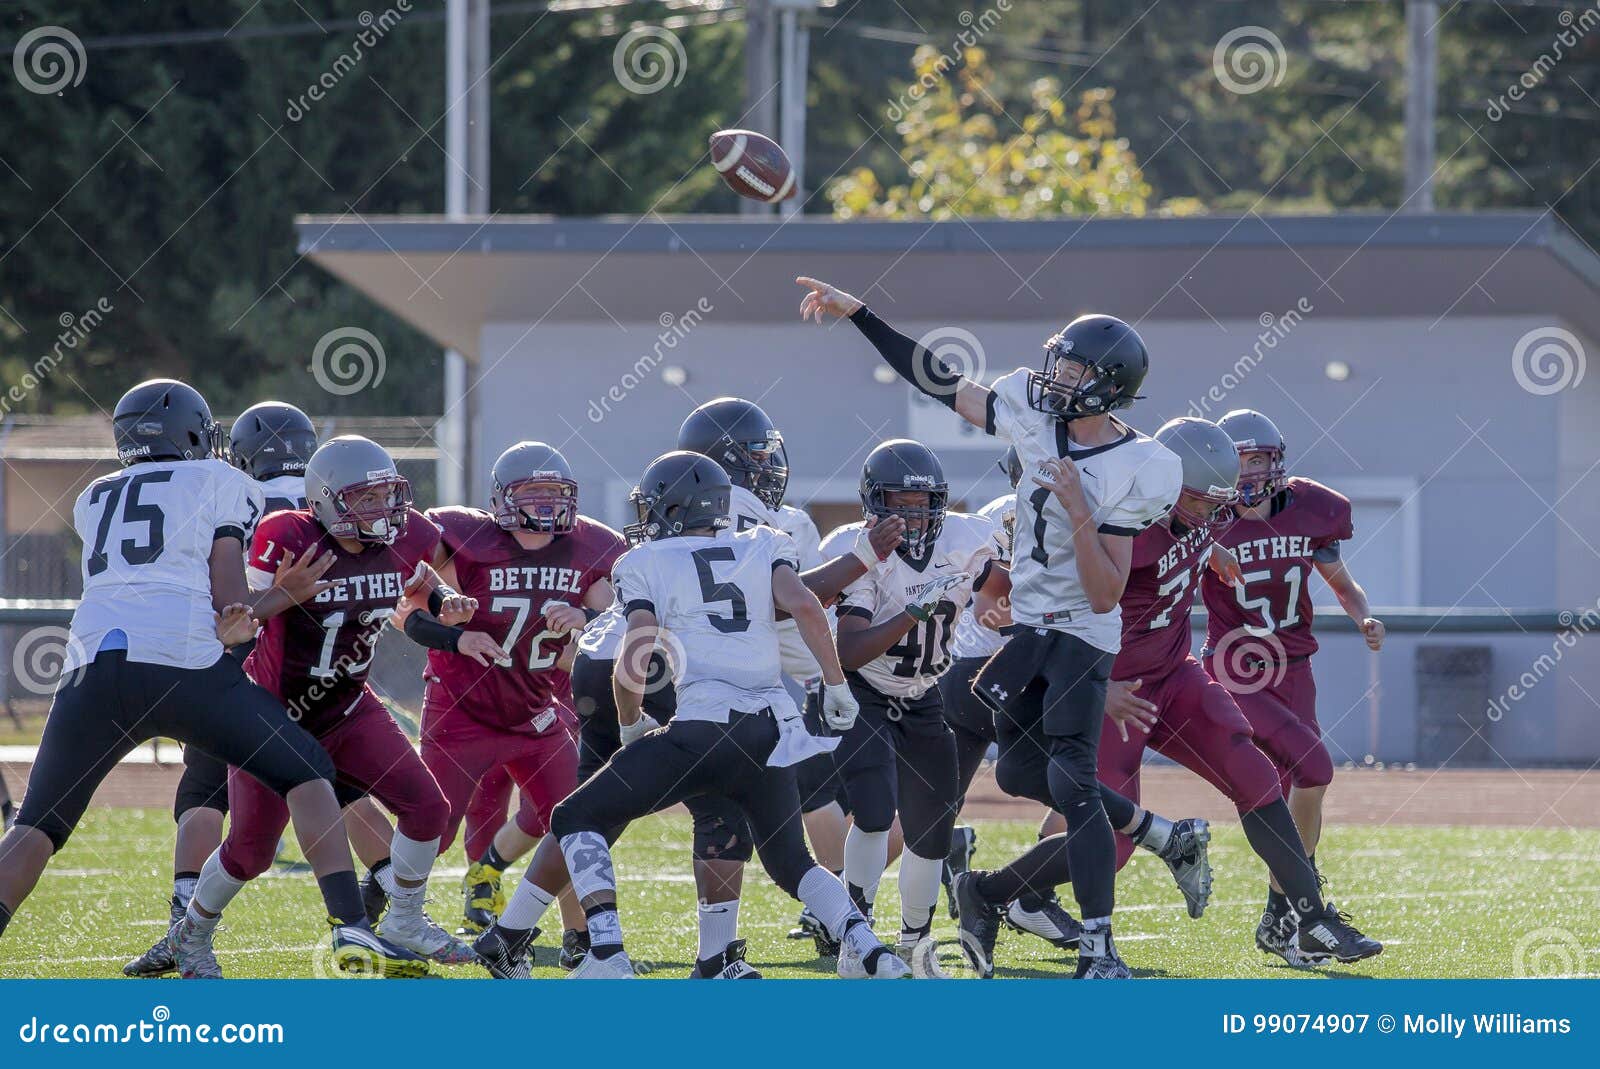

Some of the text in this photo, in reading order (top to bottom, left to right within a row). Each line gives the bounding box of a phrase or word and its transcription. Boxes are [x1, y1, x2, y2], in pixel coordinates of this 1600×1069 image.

[119, 445, 151, 460] Riddell
[88, 470, 174, 577] 75
[1029, 487, 1049, 569] 1
[489, 566, 582, 594] BETHEL
[691, 547, 752, 634] 5
[1233, 566, 1302, 638] 51
[491, 597, 571, 670] 72
[886, 600, 957, 678] 40
[722, 961, 744, 979] NIKE
